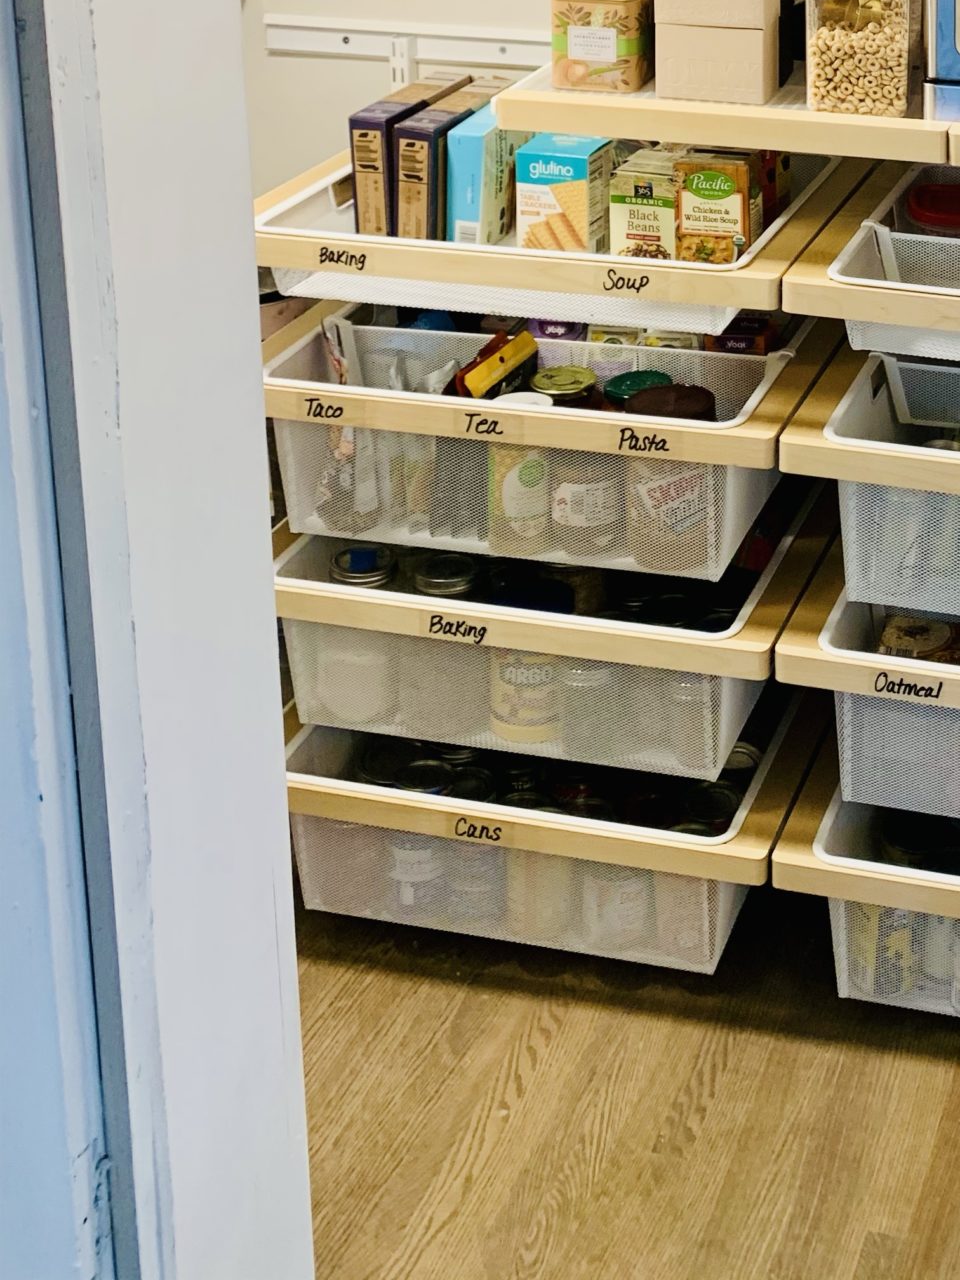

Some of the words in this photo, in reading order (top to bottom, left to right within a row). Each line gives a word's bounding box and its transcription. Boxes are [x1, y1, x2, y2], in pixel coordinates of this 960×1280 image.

[528, 159, 574, 179] glutino
[689, 173, 732, 191] Pacific
[625, 197, 664, 207] ORGANIC
[692, 206, 723, 215] Chicken
[628, 209, 660, 222] Black
[684, 213, 701, 222] Wild
[702, 214, 719, 223] Rice
[719, 216, 739, 226] Soup
[627, 220, 661, 233] Beans
[319, 246, 367, 271] Baking
[603, 269, 650, 293] Soup
[304, 398, 344, 419] Taco
[464, 413, 504, 435] Tea
[618, 428, 670, 452] Pasta
[429, 615, 488, 644] Baking
[874, 671, 943, 699] Oatmeal
[454, 817, 502, 842] Cans
